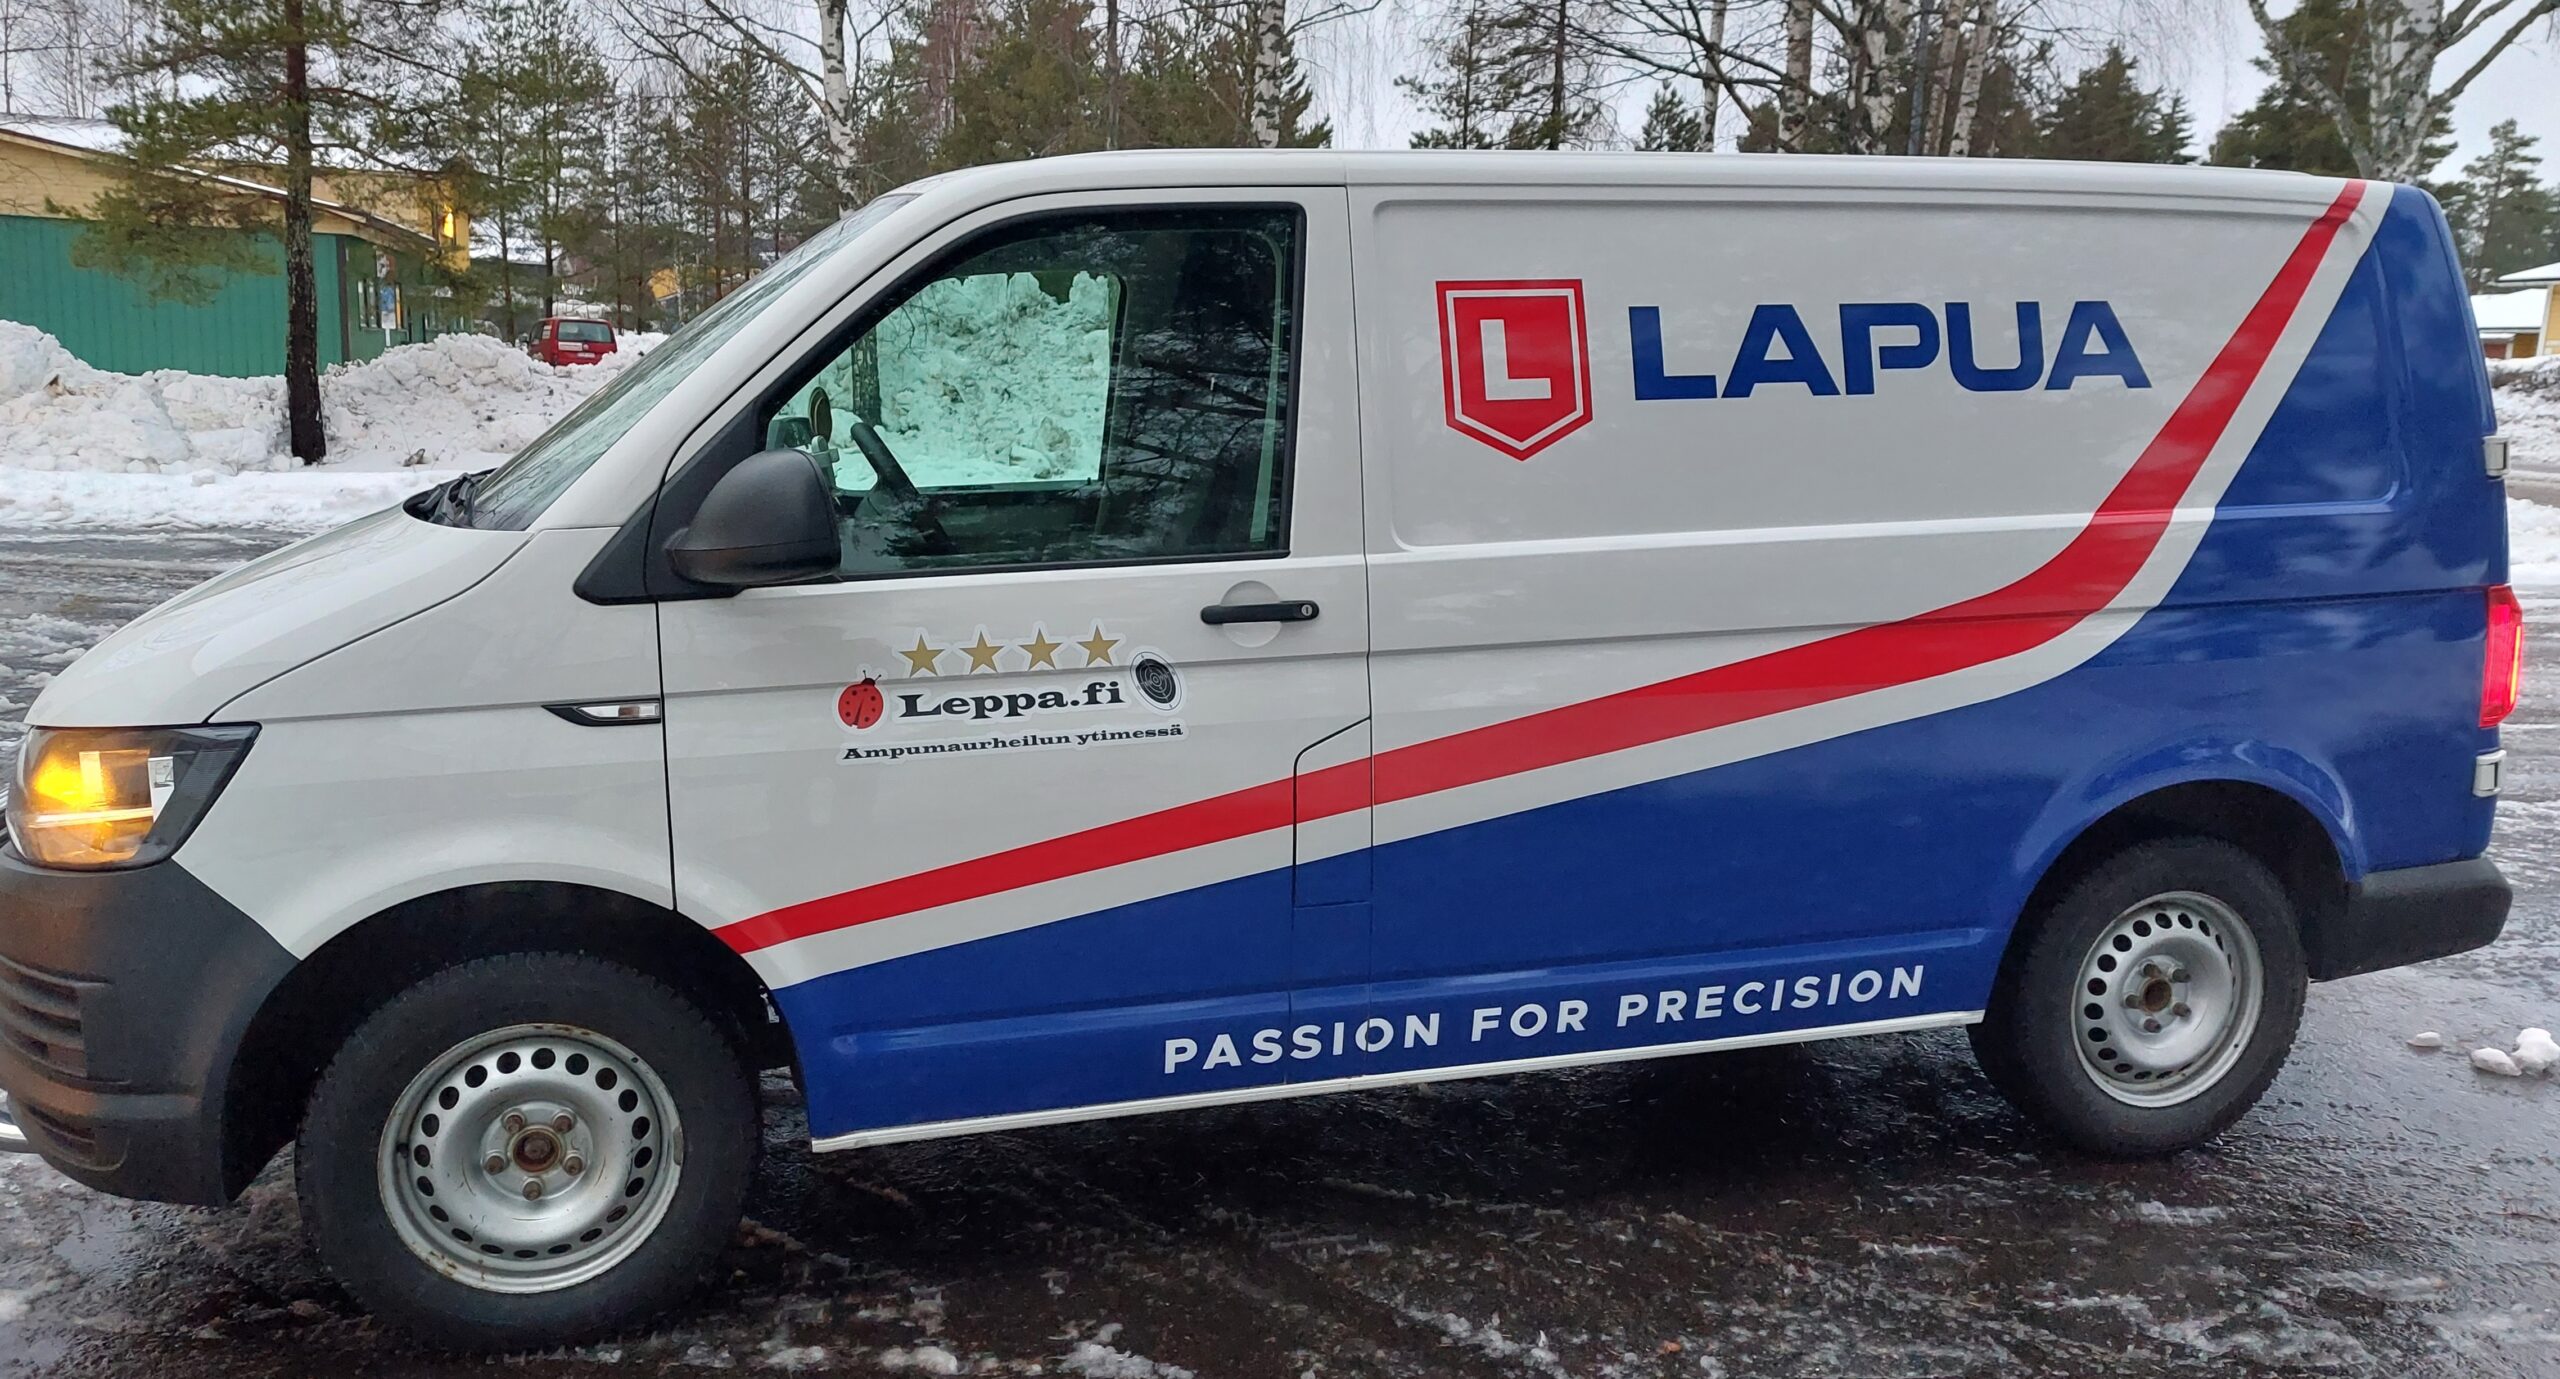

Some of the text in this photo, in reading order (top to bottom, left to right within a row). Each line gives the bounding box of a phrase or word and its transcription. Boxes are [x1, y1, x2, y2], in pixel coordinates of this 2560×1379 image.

[1479, 318, 1552, 401] L
[1628, 301, 2152, 401] LAPUA
[842, 723, 1184, 760] Ampumaurheilun ytimessä
[897, 680, 1126, 720] Leppa.fi
[1164, 965, 1924, 1074] PASSION FOR PRECISION
